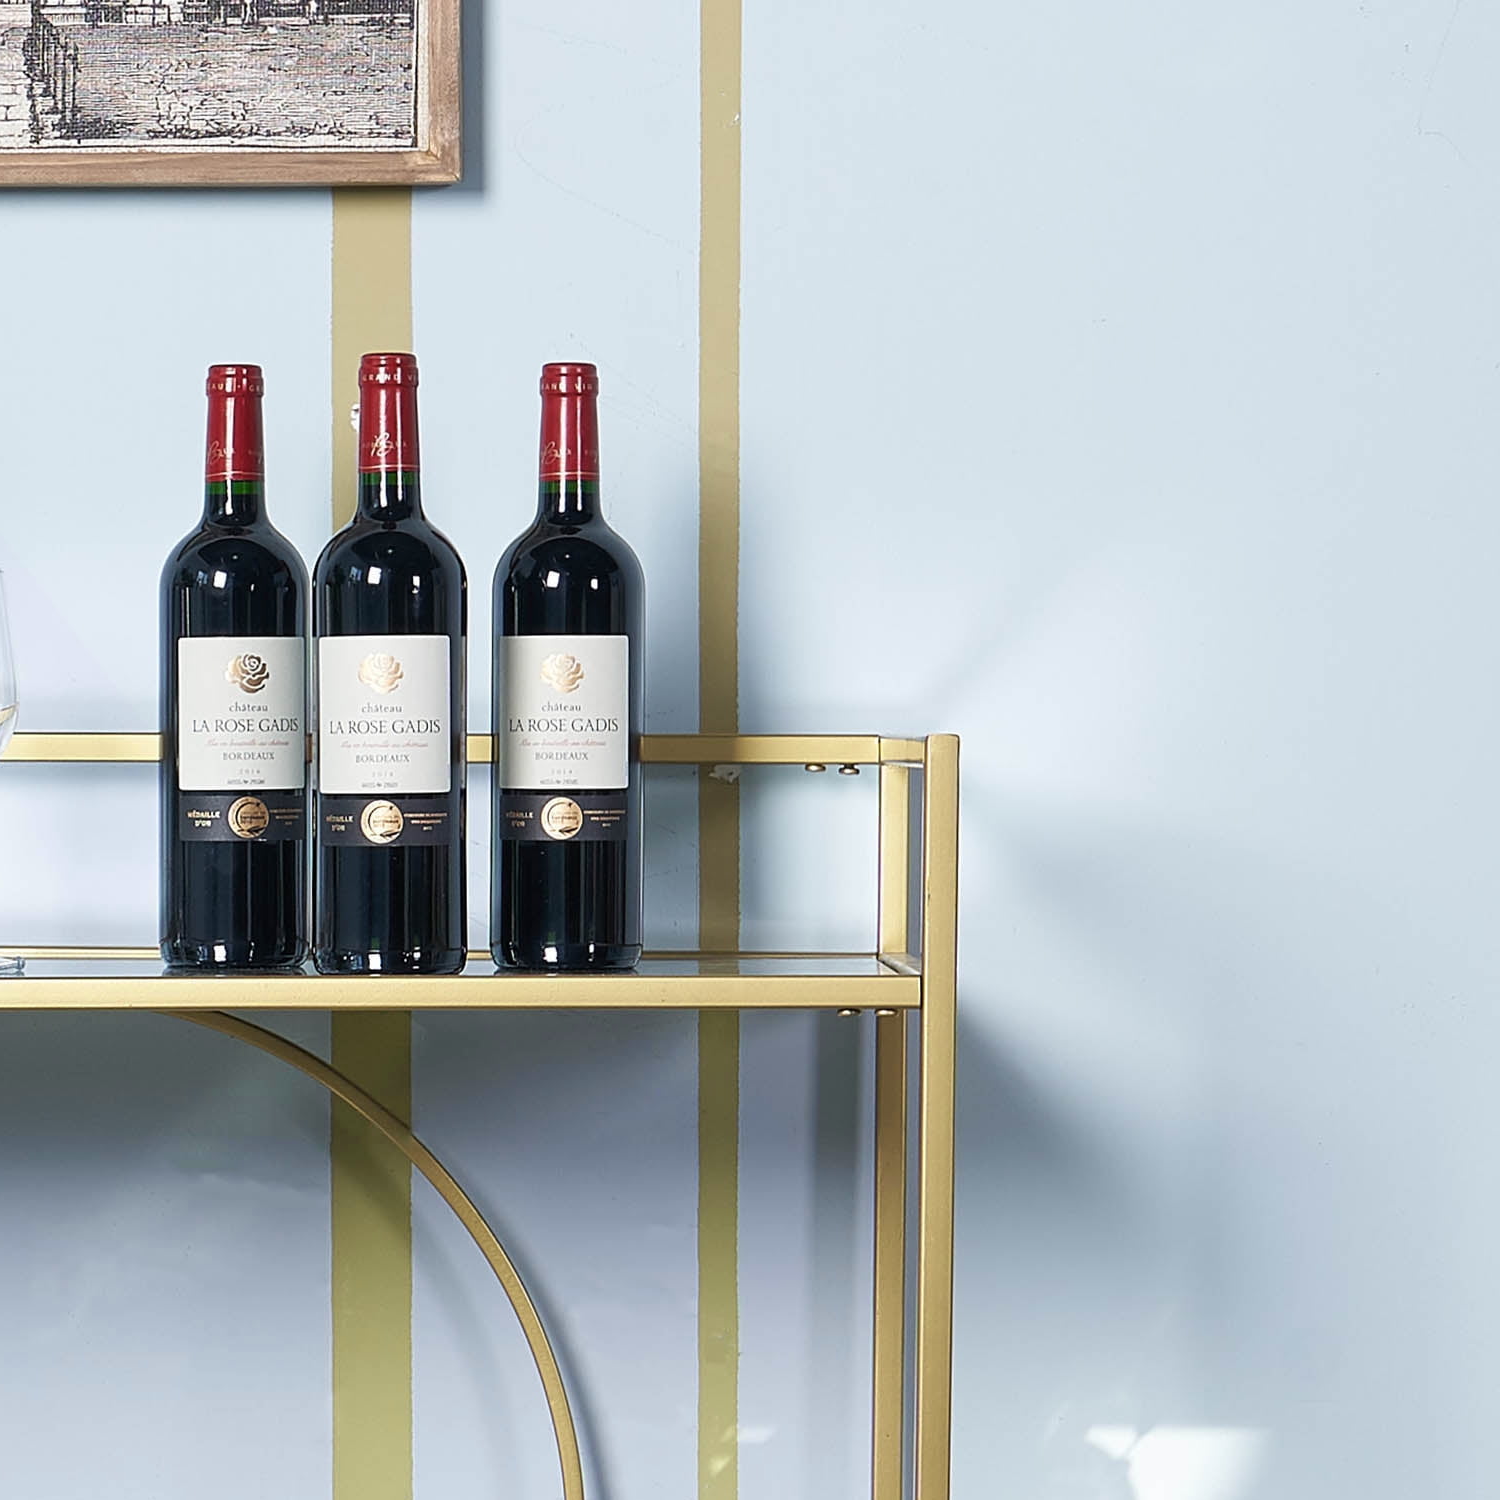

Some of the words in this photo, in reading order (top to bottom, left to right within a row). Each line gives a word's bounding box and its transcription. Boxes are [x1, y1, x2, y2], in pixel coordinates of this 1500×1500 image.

[228, 701, 269, 713] château
[361, 702, 403, 713] château
[541, 701, 582, 712] château
[192, 718, 210, 733] LA
[214, 718, 255, 733] ROSE
[258, 717, 299, 733] GADIS
[329, 719, 344, 735] LA
[348, 719, 388, 735] ROSE
[391, 718, 441, 735] GADIS
[508, 718, 524, 733] LA
[528, 718, 567, 733] ROSE
[571, 717, 619, 733] GADIS
[222, 751, 275, 761] BORDEAUX
[355, 754, 410, 764] BORDEAUX
[534, 751, 589, 761] BORDEAUX
